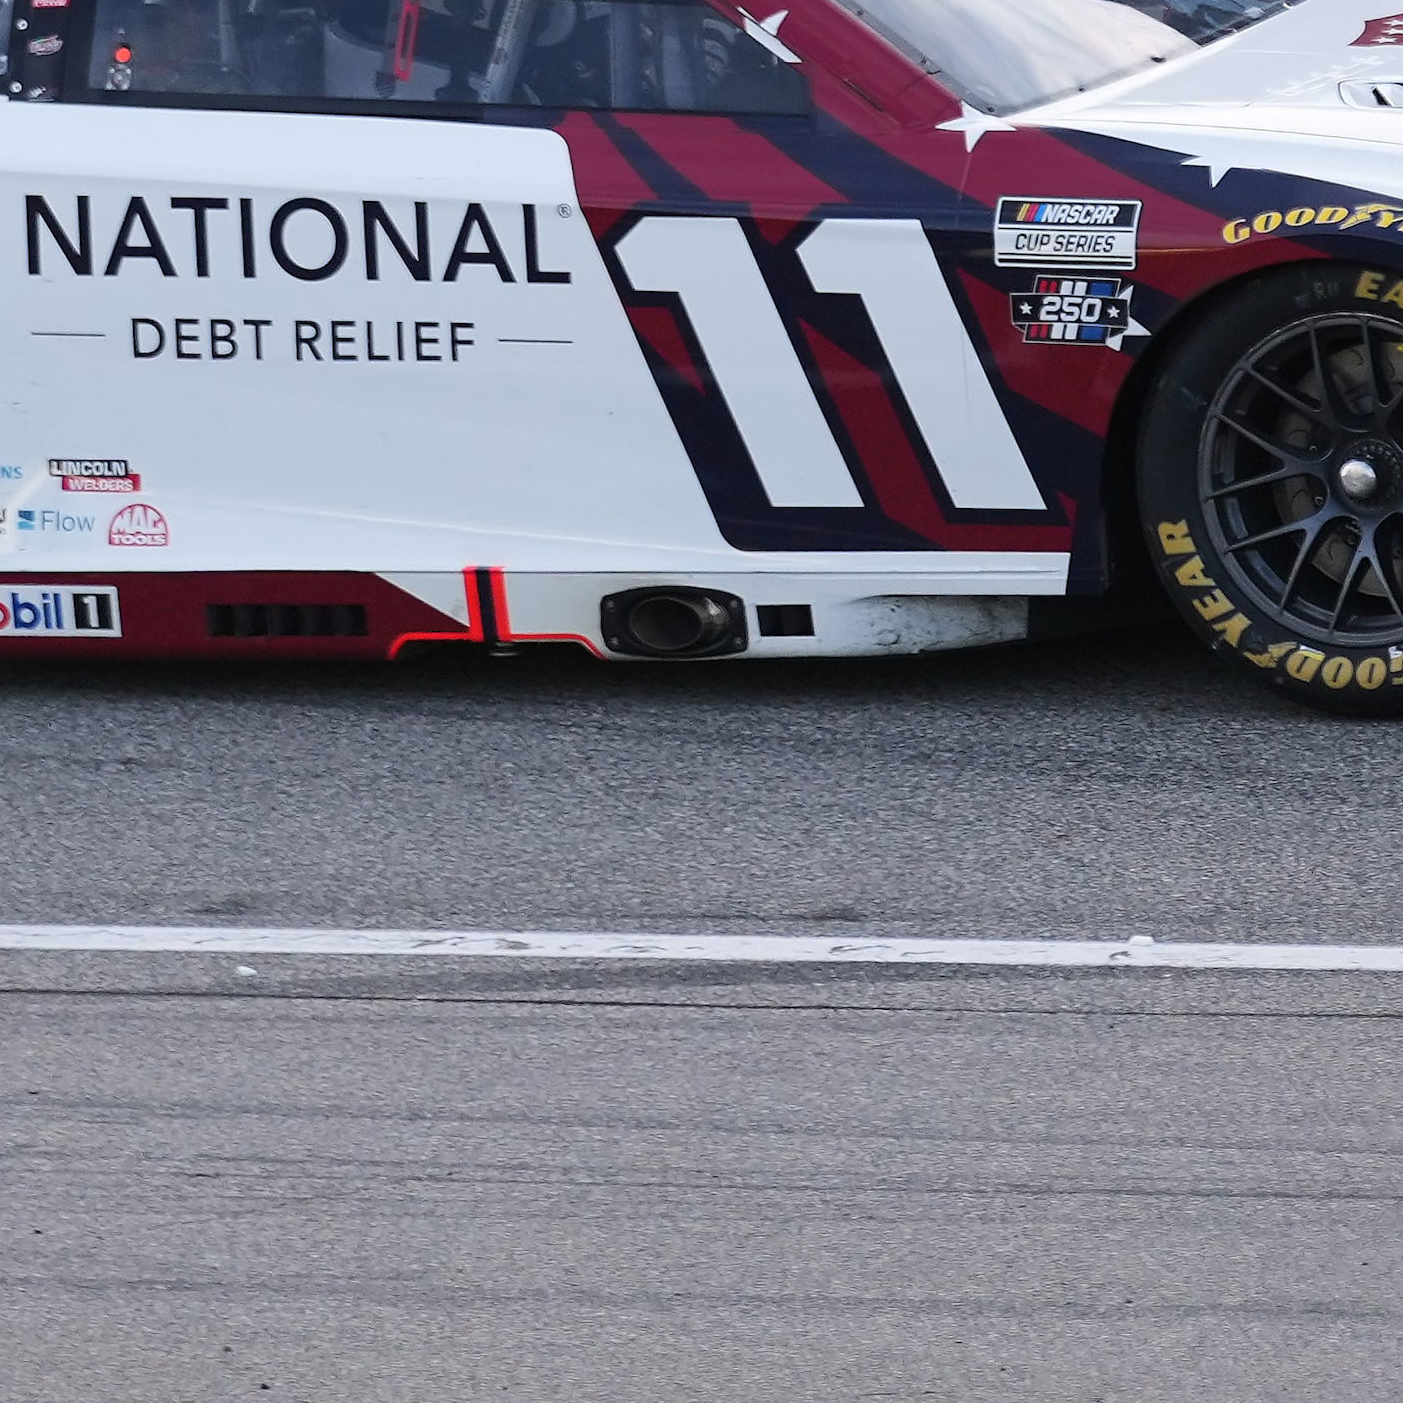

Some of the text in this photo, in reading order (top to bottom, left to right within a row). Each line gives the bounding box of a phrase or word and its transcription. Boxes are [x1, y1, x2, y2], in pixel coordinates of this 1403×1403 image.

[1041, 203, 1120, 224] NASCAR
[25, 193, 572, 285] NATIONAL
[1015, 233, 1116, 253] CUP SERIES
[1039, 295, 1102, 323] 250
[131, 317, 476, 363] DEBT RELIEF
[613, 215, 1048, 510] 11
[50, 460, 126, 476] LINCOLN
[69, 478, 134, 491] WELDERS
[41, 510, 96, 532] Flow
[110, 533, 167, 546] TOOLS
